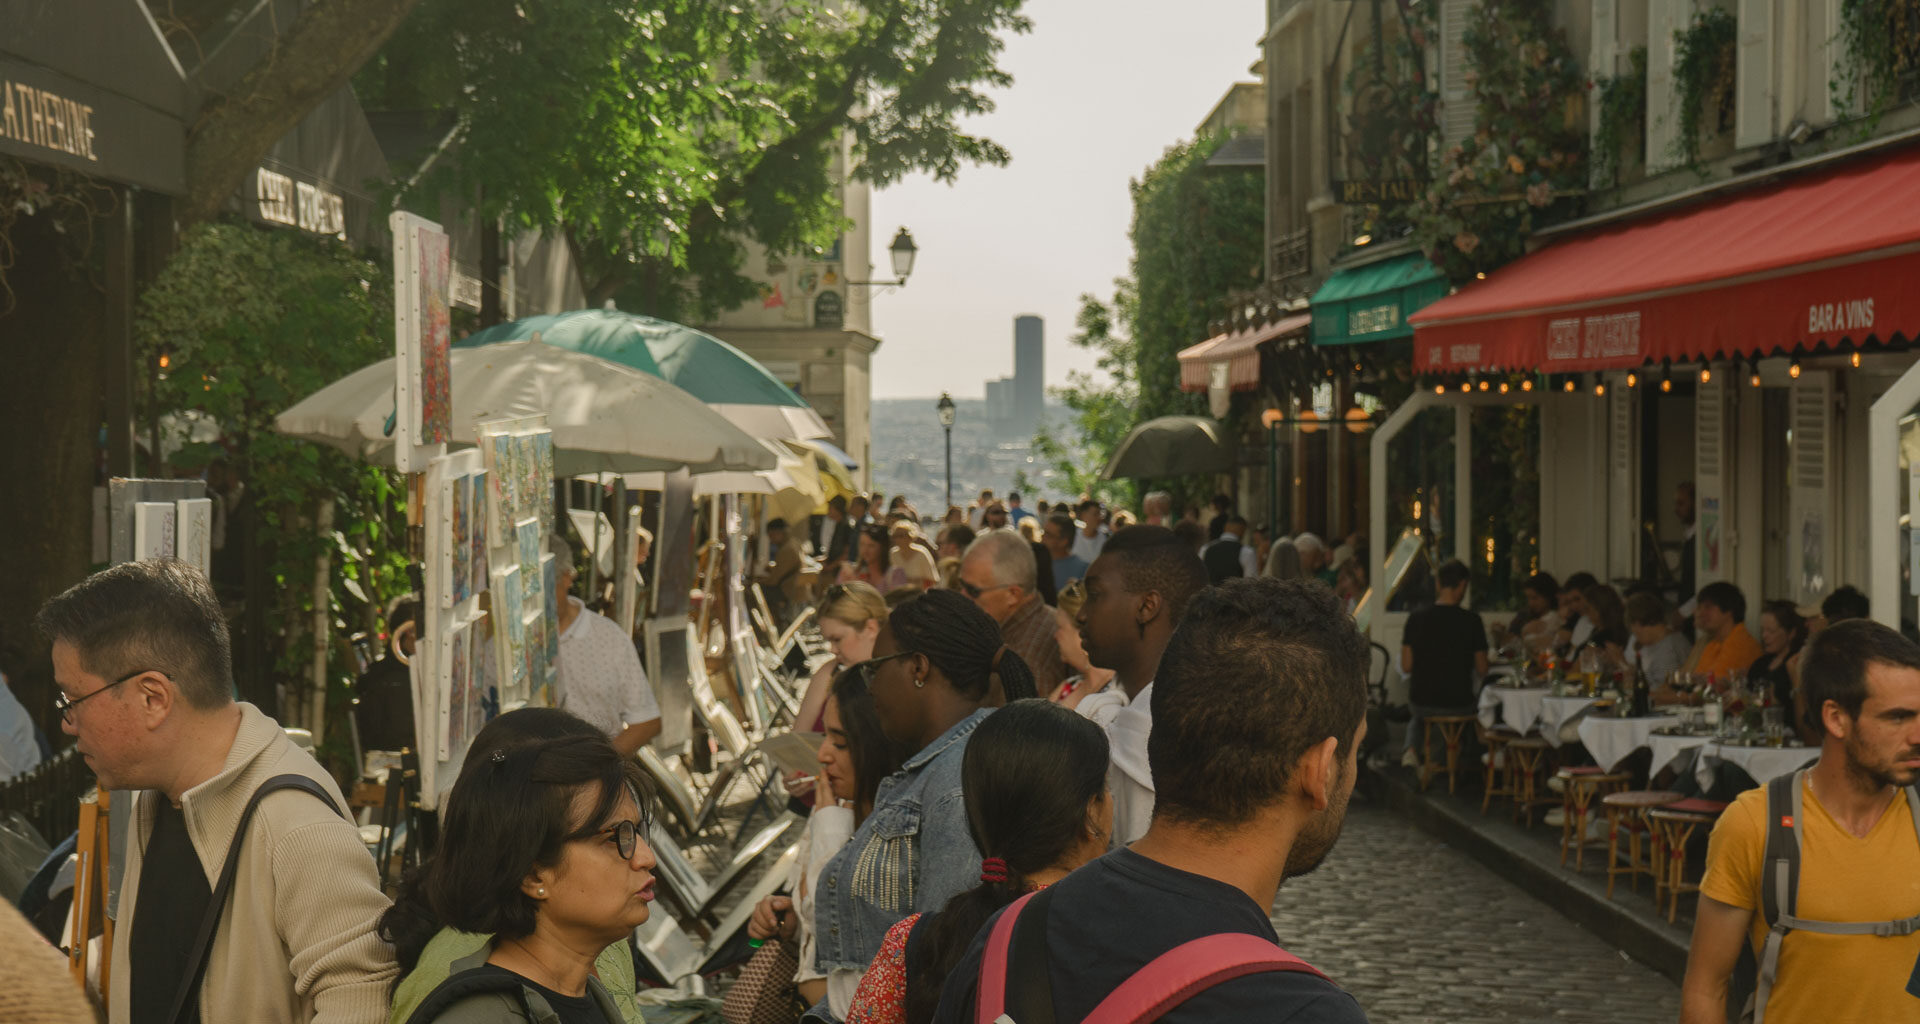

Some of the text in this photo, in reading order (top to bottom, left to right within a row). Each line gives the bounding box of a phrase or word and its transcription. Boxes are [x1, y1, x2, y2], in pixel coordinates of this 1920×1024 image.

[0, 80, 98, 161] ATHERINE
[1808, 296, 1874, 333] BAR A VINS
[1547, 317, 1581, 360] CHEZ
